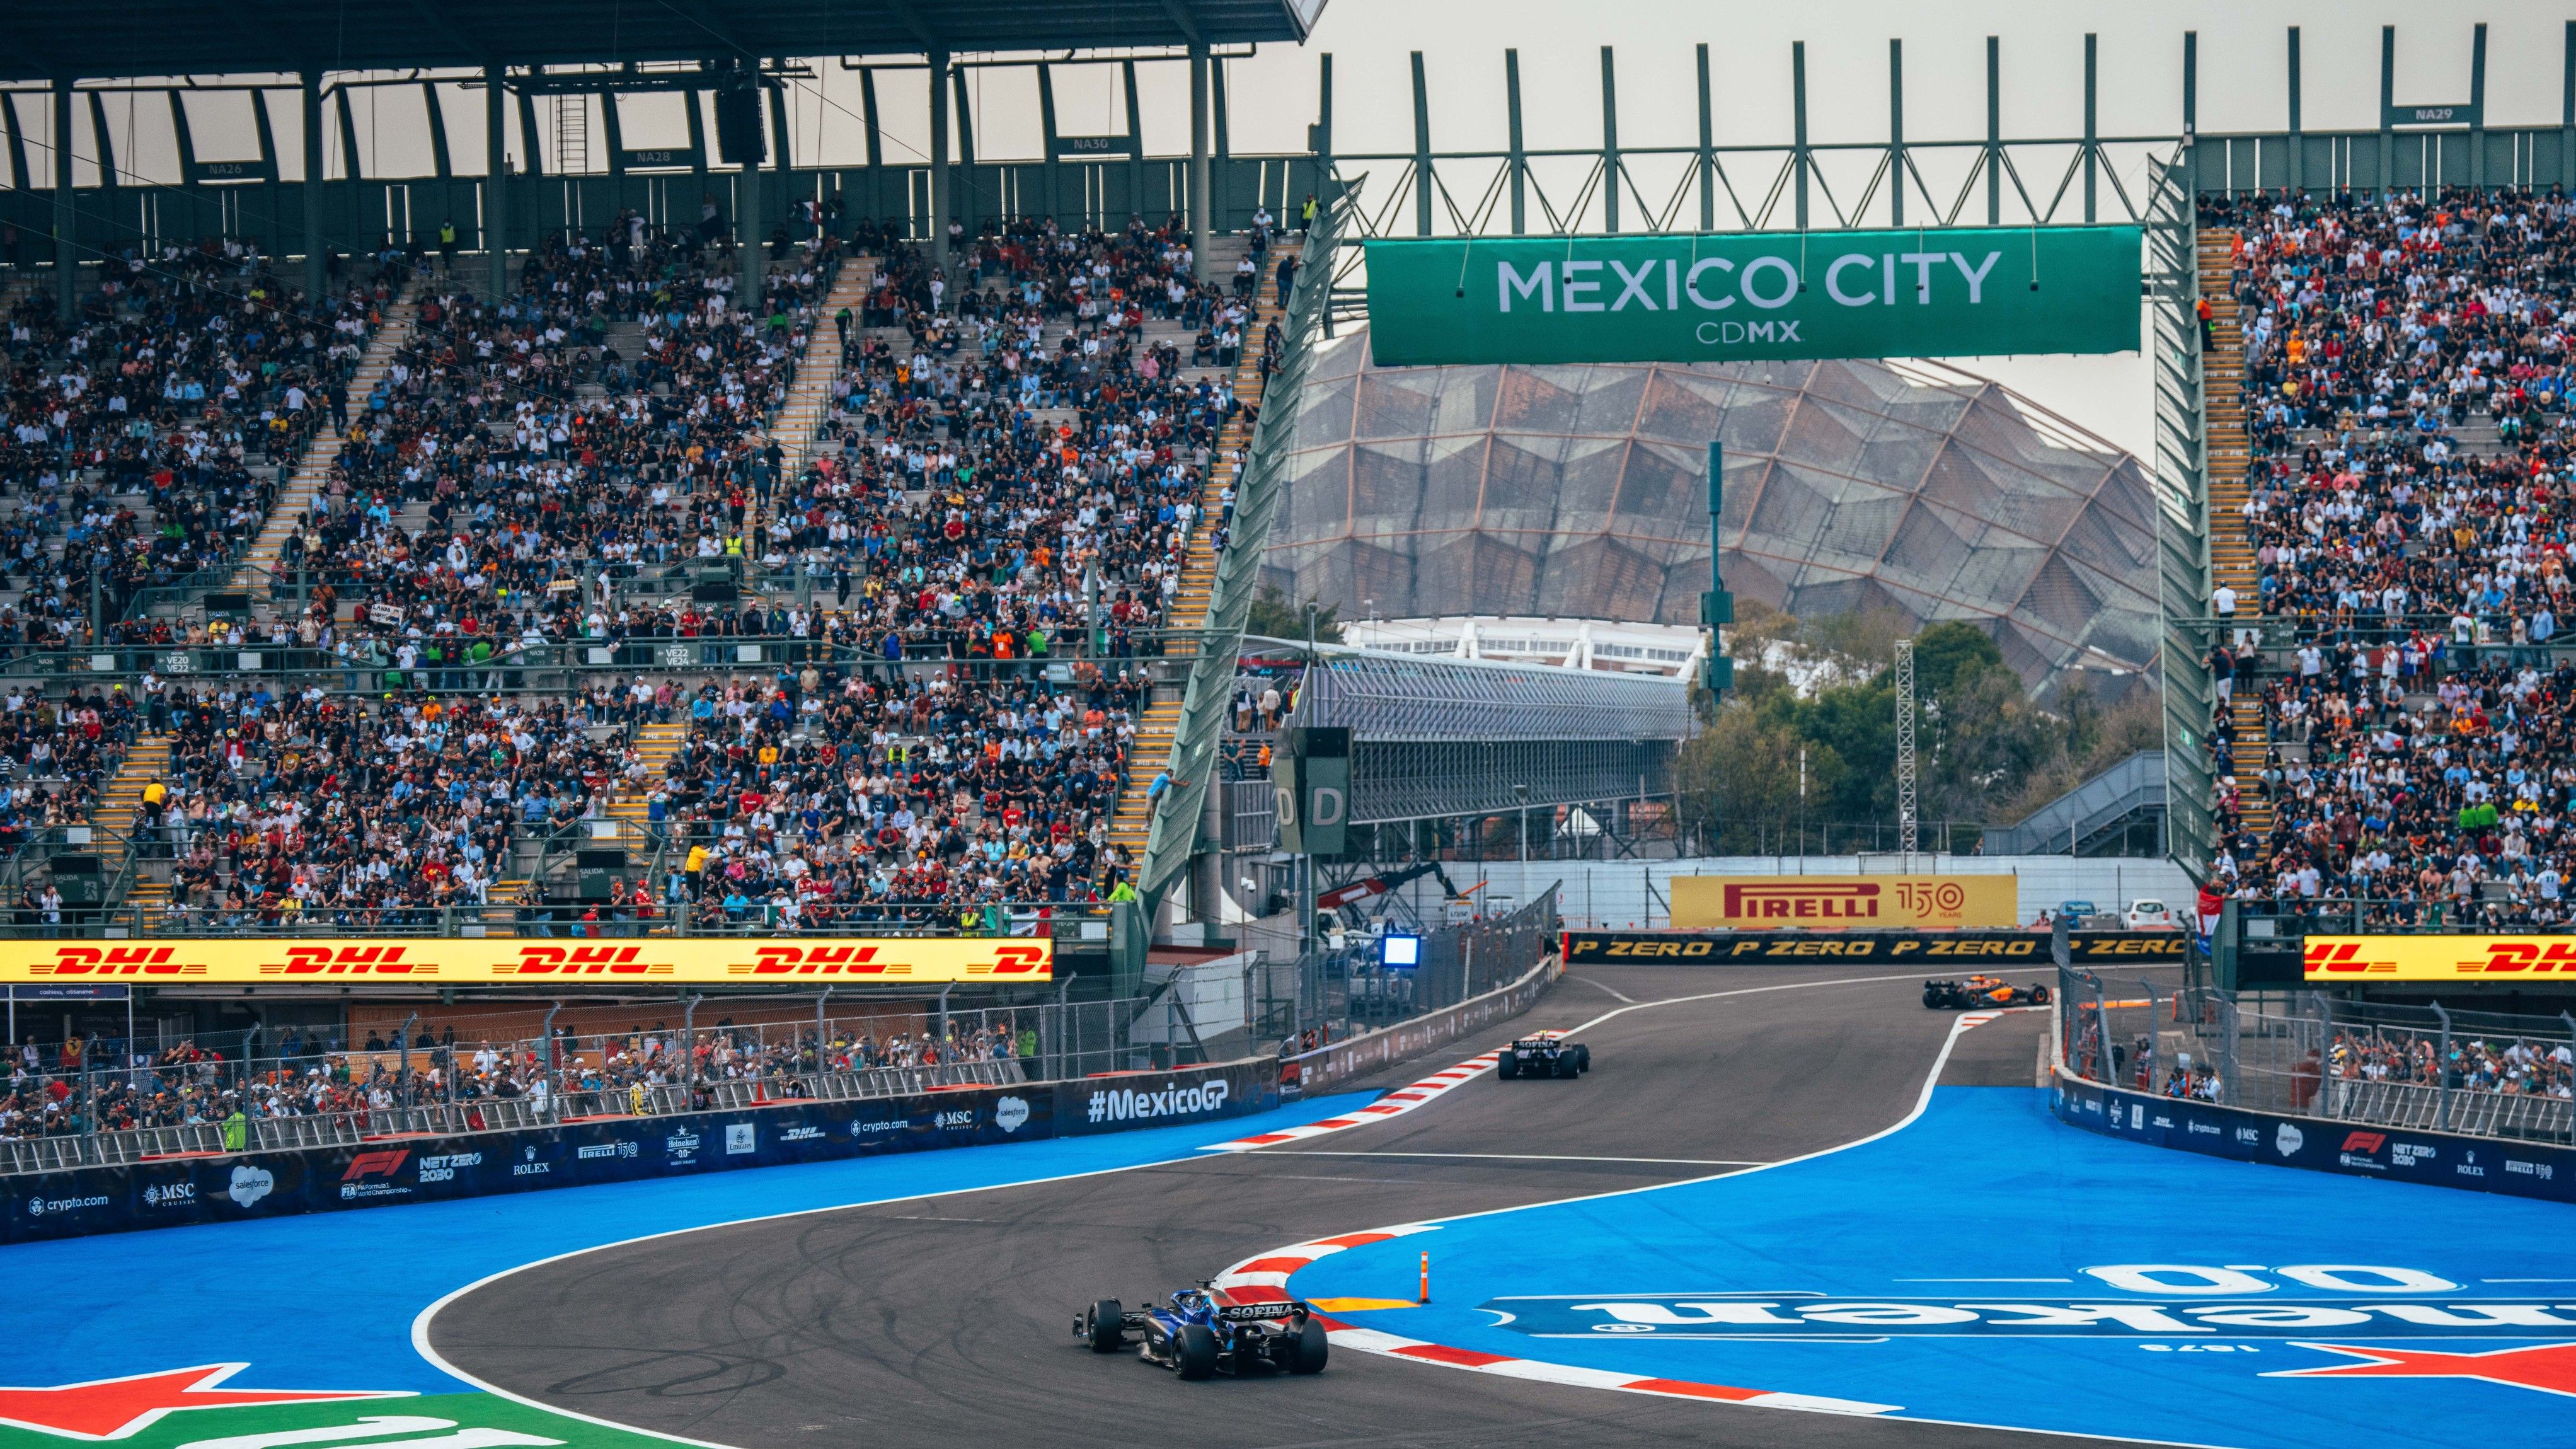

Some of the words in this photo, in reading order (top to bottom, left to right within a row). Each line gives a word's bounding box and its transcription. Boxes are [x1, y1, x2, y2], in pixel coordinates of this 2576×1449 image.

[2415, 108, 2453, 120] NA29
[1074, 139, 1108, 149] NA30
[637, 152, 670, 162] NA28
[209, 164, 242, 174] NA26
[1497, 256, 1797, 313] MEXICO
[1826, 250, 2001, 306] CITY
[1696, 320, 1801, 344] CDMX
[372, 604, 390, 613] LANDO
[666, 657, 689, 666] VE24
[1312, 788, 1343, 826] D
[1724, 883, 1880, 918] PIRELLI
[1896, 882, 1964, 918] 150
[1572, 941, 1599, 955] P
[1606, 941, 1712, 955] ZERO
[1732, 941, 1760, 955] P
[1766, 941, 1876, 955] ZERO
[1892, 941, 1920, 955] P
[1926, 940, 2037, 955] ZERO
[54, 947, 183, 974] DHL
[284, 947, 414, 974] DHL
[517, 947, 649, 973] DHL
[754, 947, 887, 974] DHL
[1088, 1080, 1228, 1123] #MexicoGP
[946, 1111, 972, 1124] MSC
[1000, 1107, 1026, 1117] salesforce
[862, 1119, 908, 1132] crypto.com
[787, 1127, 817, 1140] DHL
[669, 1139, 697, 1148] Heineken
[2341, 1131, 2386, 1154] F1
[578, 1144, 614, 1158] PIRELLI
[617, 1142, 638, 1158] 150
[678, 1150, 687, 1158] 0.0
[2393, 1143, 2410, 1155] NET
[2412, 1145, 2435, 1158] ZERO
[341, 1150, 410, 1181] F1
[420, 1155, 447, 1169] NET
[451, 1152, 481, 1166] ZERO
[2505, 1160, 2534, 1174] PIRELLI
[420, 1168, 454, 1182] 2030
[514, 1163, 549, 1175] ROLEX
[2458, 1164, 2483, 1176] ROLEX
[161, 1183, 195, 1199] MSC
[236, 1178, 269, 1190] salesforce
[342, 1186, 357, 1198] FIA
[372, 1187, 408, 1196] Championship
[47, 1196, 108, 1211] crypto.com
[2083, 1264, 2461, 1294] 0.0
[1229, 1304, 1293, 1320] SOFINA
